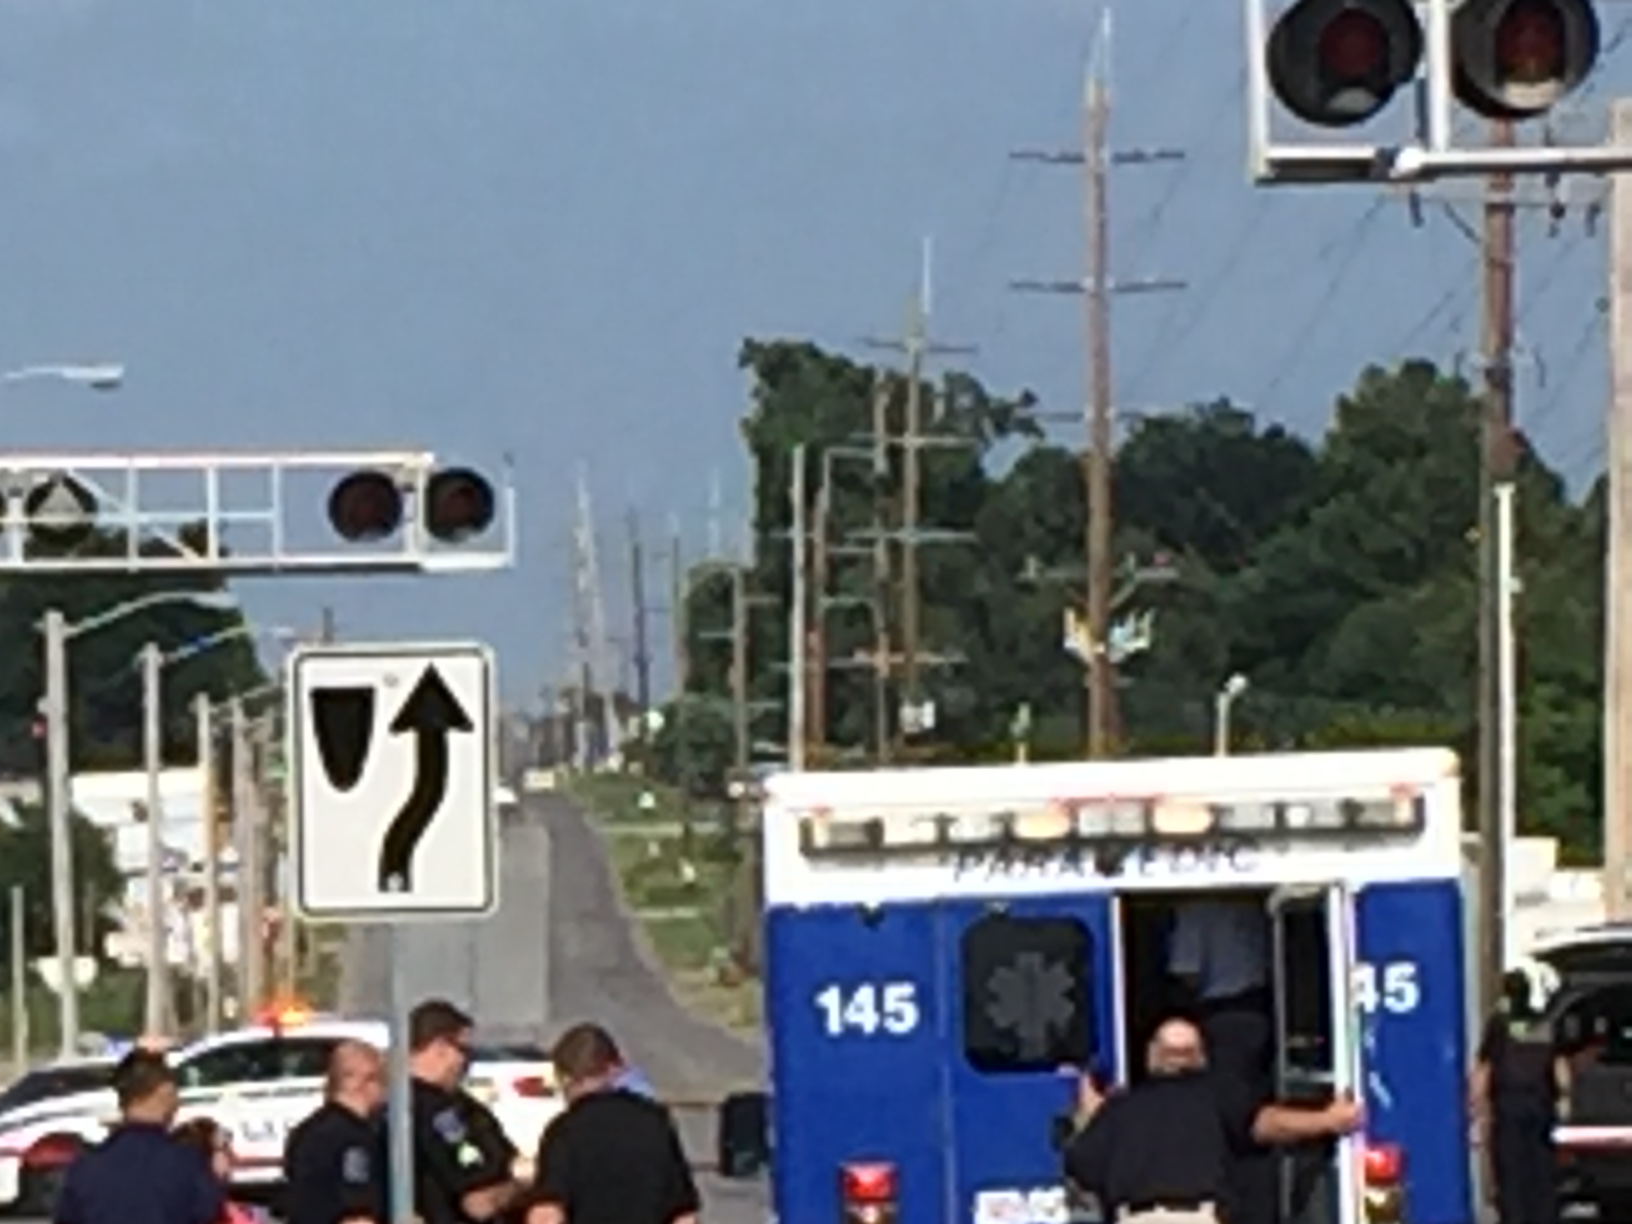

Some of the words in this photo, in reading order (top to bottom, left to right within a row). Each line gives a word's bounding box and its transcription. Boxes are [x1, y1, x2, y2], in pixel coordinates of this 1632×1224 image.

[953, 842, 1261, 882] PARAEDIC
[814, 982, 920, 1036] 145
[1349, 961, 1420, 1014] 45
